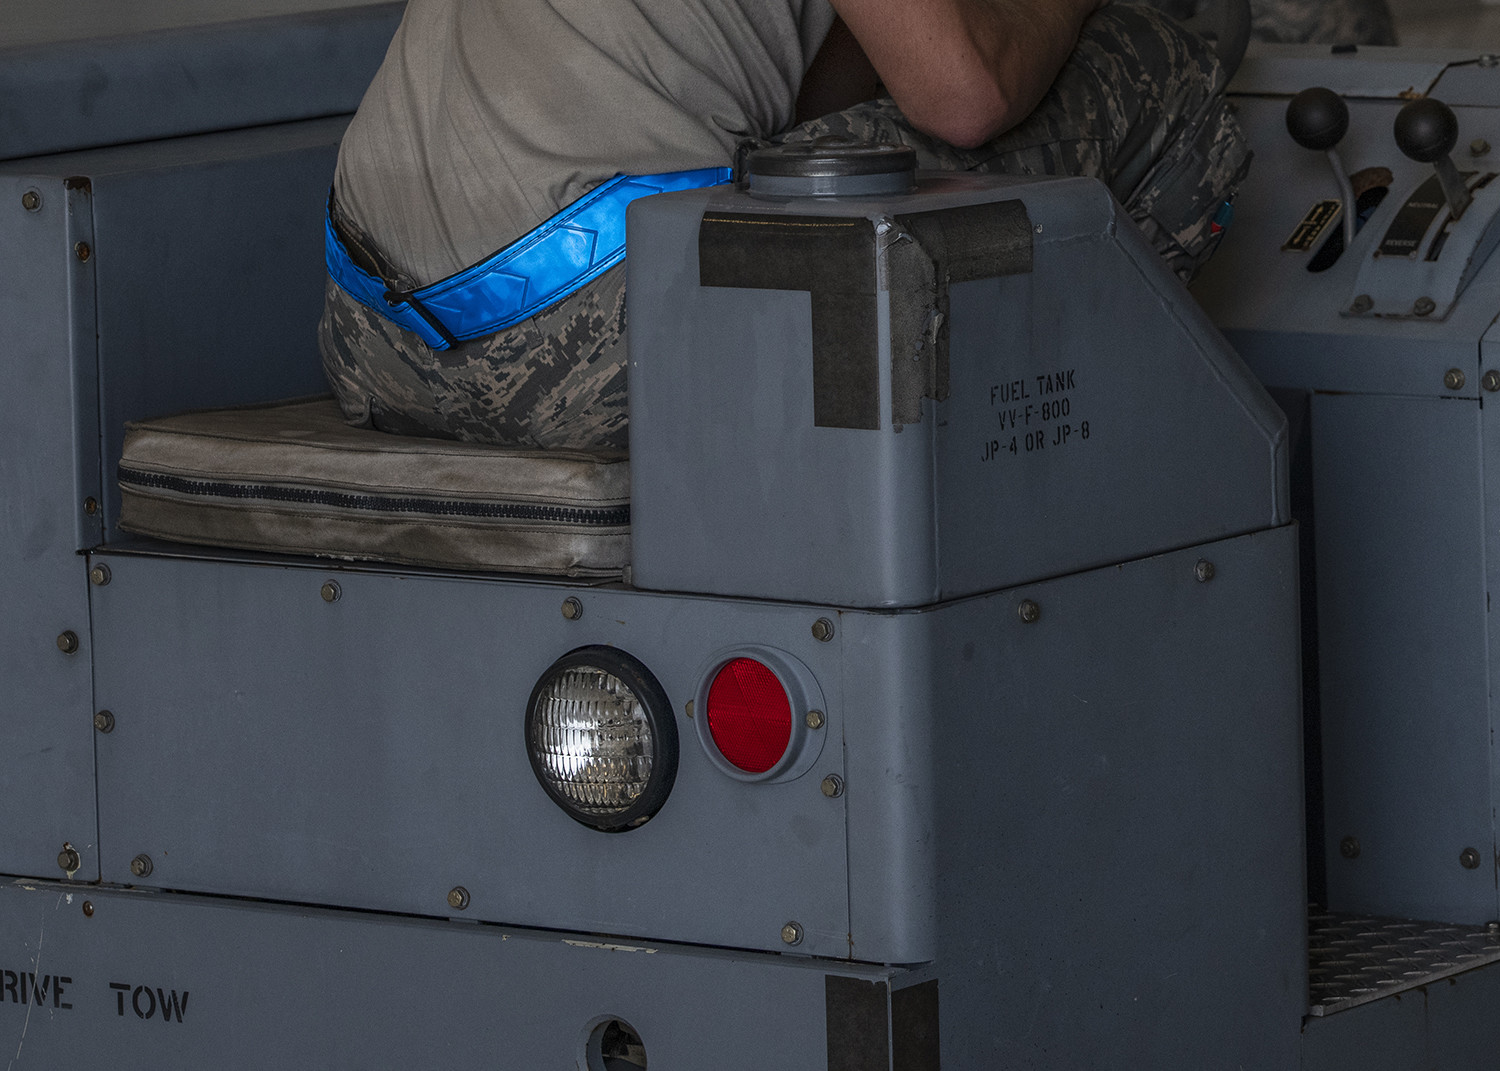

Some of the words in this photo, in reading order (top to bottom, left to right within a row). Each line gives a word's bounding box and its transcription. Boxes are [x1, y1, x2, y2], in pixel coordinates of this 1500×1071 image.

[990, 379, 1030, 406] FUEL
[1036, 369, 1076, 395] TANK
[981, 436, 1018, 462] JP-4
[1025, 430, 1045, 452] OR
[1052, 420, 1090, 446] JP-8
[109, 982, 189, 1024] TOW
